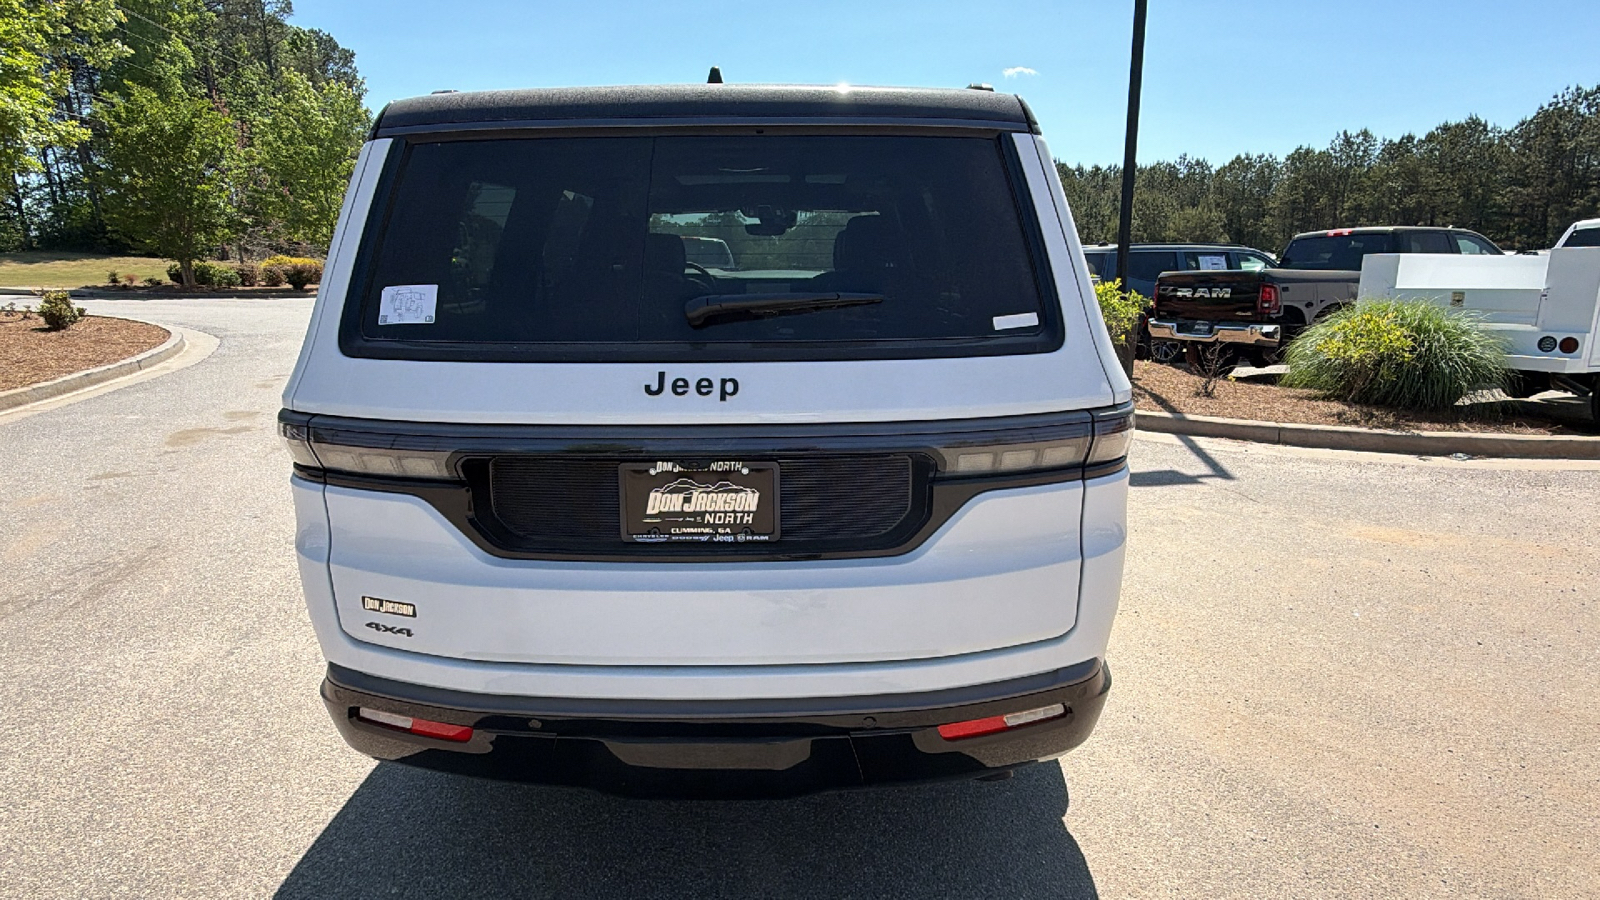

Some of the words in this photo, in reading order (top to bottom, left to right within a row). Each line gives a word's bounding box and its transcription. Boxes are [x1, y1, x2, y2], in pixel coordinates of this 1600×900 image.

[1177, 288, 1231, 299] RAM
[644, 371, 739, 402] Jeep
[656, 462, 673, 472] DON
[710, 462, 742, 472] NORTH
[646, 492, 684, 514] DON
[683, 492, 760, 513] JACKSON
[704, 513, 754, 524] NORTH
[713, 534, 734, 542] Jeep
[364, 597, 380, 610] DON
[380, 600, 414, 616] JACKSON
